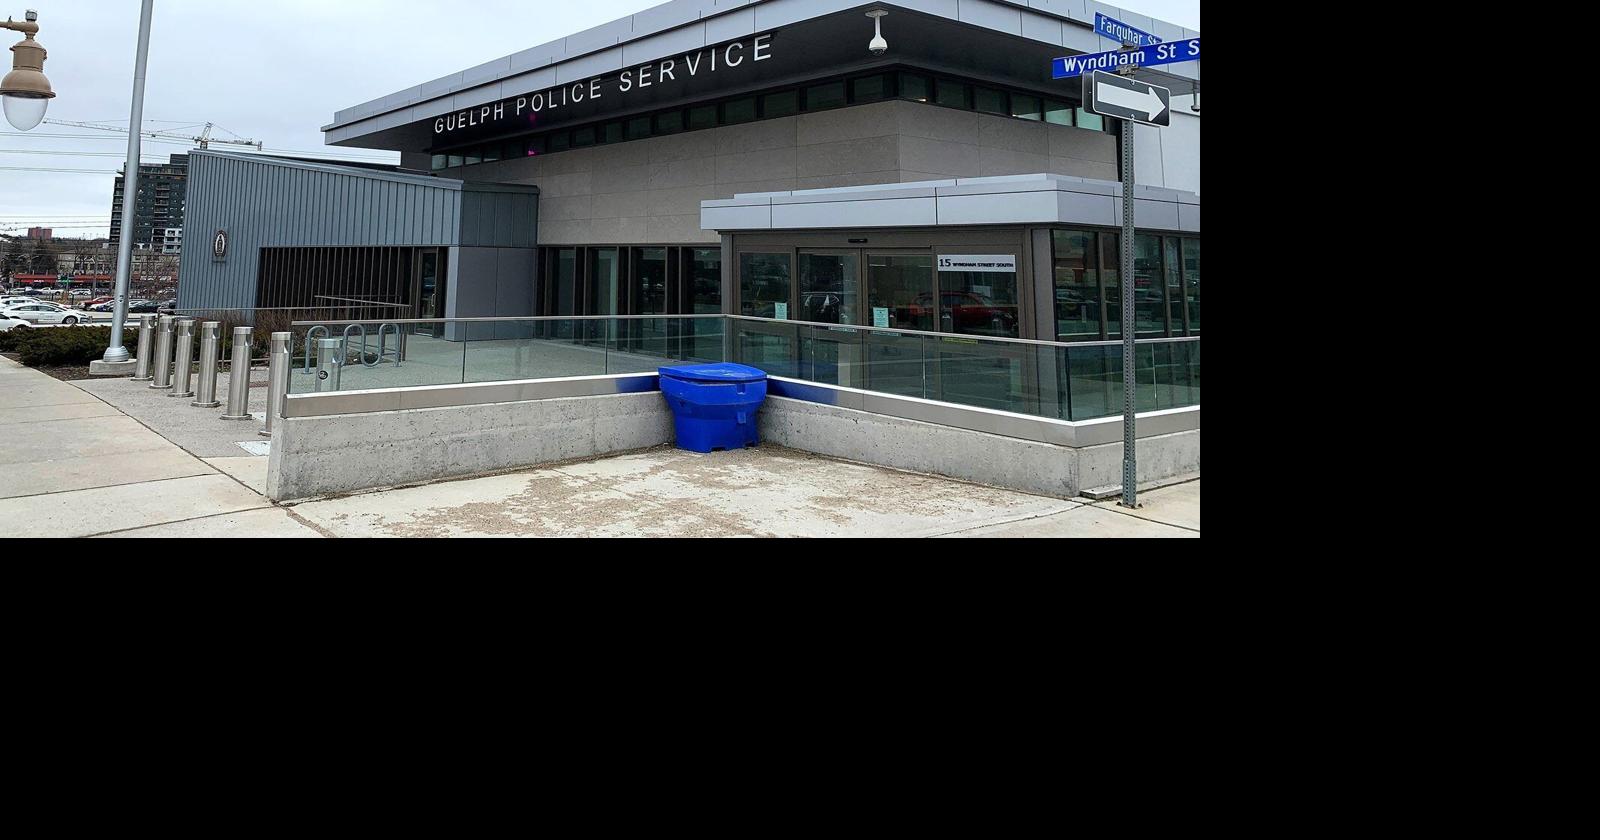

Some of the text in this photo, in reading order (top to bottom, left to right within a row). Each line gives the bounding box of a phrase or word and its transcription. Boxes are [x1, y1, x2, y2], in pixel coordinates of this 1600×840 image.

[1101, 17, 1156, 45] Farquhar St
[1064, 39, 1200, 73] Wyndham St S
[434, 33, 773, 134] GUELPH POLICE SERVICE
[939, 259, 951, 267] 15
